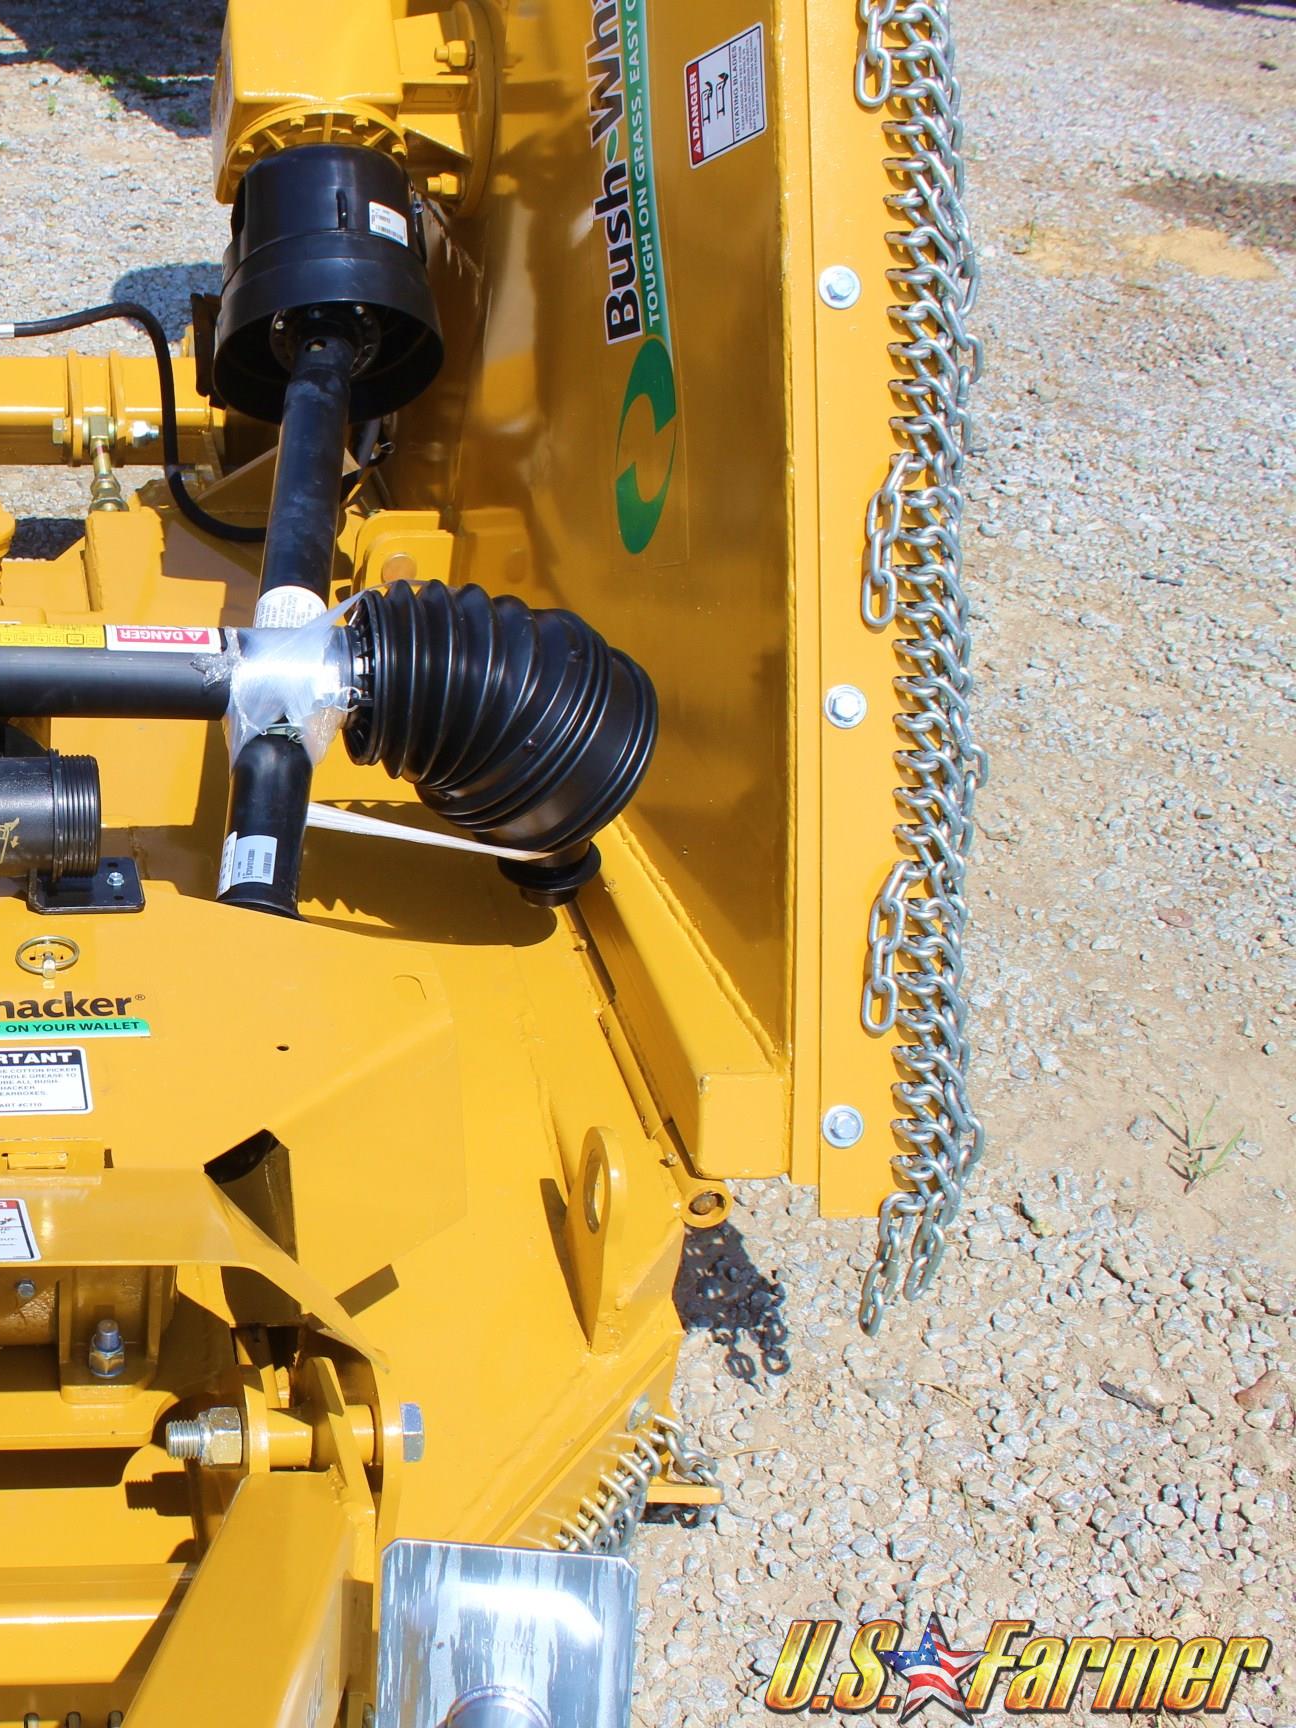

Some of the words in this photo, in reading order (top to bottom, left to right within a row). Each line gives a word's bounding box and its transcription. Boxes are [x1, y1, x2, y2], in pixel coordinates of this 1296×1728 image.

[626, 20, 640, 84] EASY
[632, 88, 646, 182] GRASS,
[689, 71, 700, 140] DANGER
[636, 188, 650, 228] ON
[595, 160, 642, 345] Bush
[641, 233, 661, 327] TOUGH
[120, 628, 183, 641] DANGER
[6, 1024, 29, 1032] ON
[33, 1022, 78, 1032] YOUR
[79, 1021, 140, 1031] WALLET
